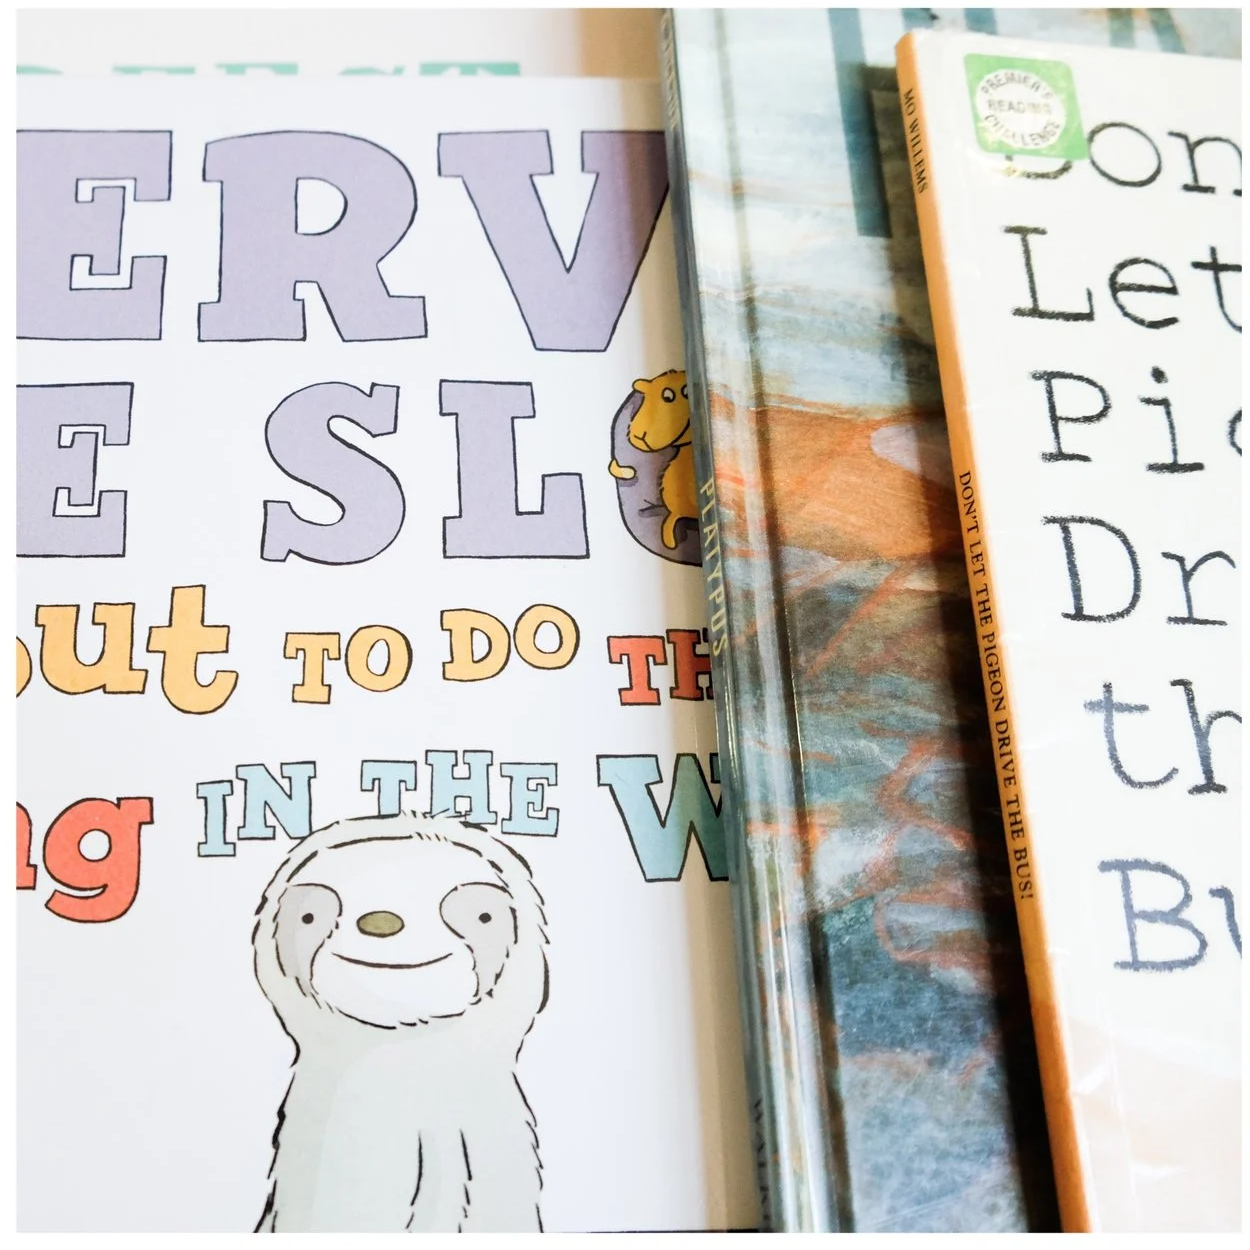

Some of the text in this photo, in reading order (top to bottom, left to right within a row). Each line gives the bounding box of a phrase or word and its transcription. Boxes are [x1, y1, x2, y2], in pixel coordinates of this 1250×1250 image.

[902, 86, 929, 194] MO WILLEMS
[699, 477, 729, 659] PLATYPUS
[285, 624, 412, 705] TO
[441, 603, 580, 682] DO
[958, 470, 1037, 901] DON'T LET THE PIGEON DRIVE THE BUS!
[196, 760, 317, 858] IN
[360, 749, 560, 838] THE
